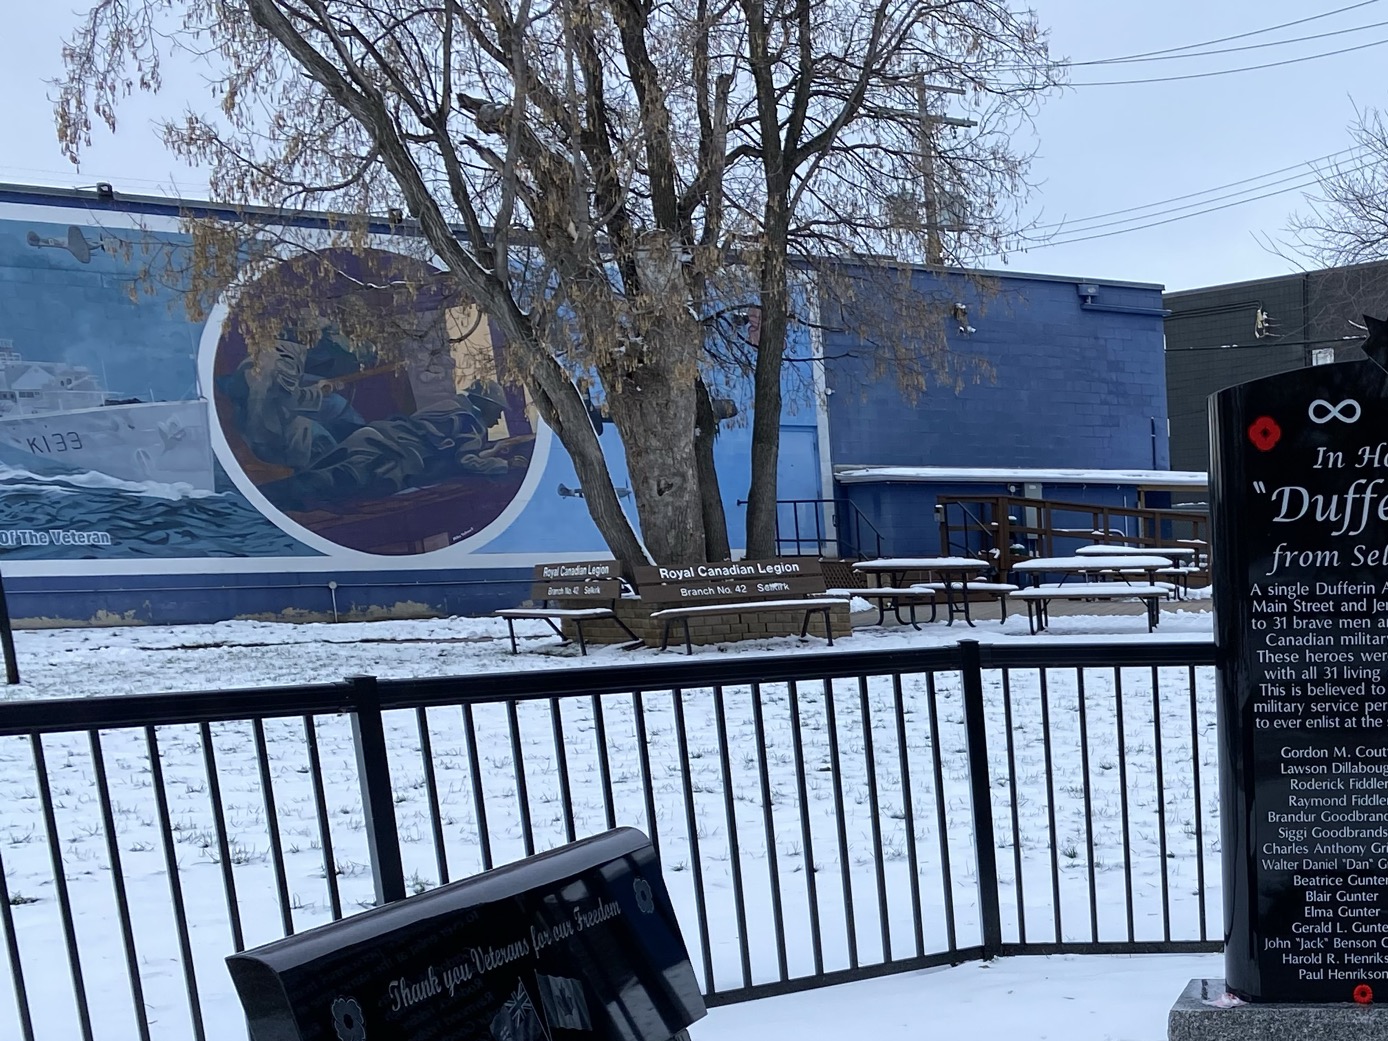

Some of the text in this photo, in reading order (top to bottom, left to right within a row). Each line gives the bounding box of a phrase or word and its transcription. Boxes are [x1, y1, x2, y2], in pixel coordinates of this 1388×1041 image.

[26, 431, 83, 454] K133
[1313, 447, 1345, 468] In
[0, 529, 112, 545] Of The Veteran
[1266, 543, 1340, 576] from
[543, 563, 609, 579] Royal Canadian Legion
[659, 562, 800, 580] Royal Canadian Legion
[680, 586, 715, 597] Branch
[735, 584, 747, 593] 42
[1250, 583, 1262, 596] A
[1268, 582, 1309, 600] single
[1316, 580, 1375, 595] Dufferin
[1252, 618, 1266, 630] to
[1273, 616, 1286, 629] 31
[1293, 616, 1332, 629] brave
[1339, 618, 1371, 628] men
[1256, 650, 1299, 663] These
[1306, 649, 1354, 662] heroes
[1259, 683, 1286, 696] This
[1292, 684, 1302, 696] is
[1308, 682, 1365, 696] believed
[1371, 684, 1386, 695] to
[1281, 746, 1328, 758] Gordon
[1334, 746, 1351, 758] M.
[1281, 763, 1327, 774] Lawson
[1290, 778, 1344, 790] Roderick
[1268, 810, 1316, 822] Brandur
[1263, 842, 1309, 854] Charles
[1314, 842, 1366, 856] Anthony
[1262, 858, 1299, 870] Walter
[1303, 858, 1338, 870] Daniel
[1294, 875, 1343, 886] Beatrice
[1306, 890, 1379, 902] Blair Gunter
[1292, 922, 1332, 933] Gerald
[1337, 922, 1347, 933] L.
[1264, 937, 1291, 950] John
[1334, 938, 1376, 948] Benson
[388, 897, 621, 1012] Thank you Veterans for our Freedom
[1282, 953, 1322, 964] Harold
[1327, 953, 1339, 964] R.
[1299, 968, 1388, 980] Paul Henrikson
